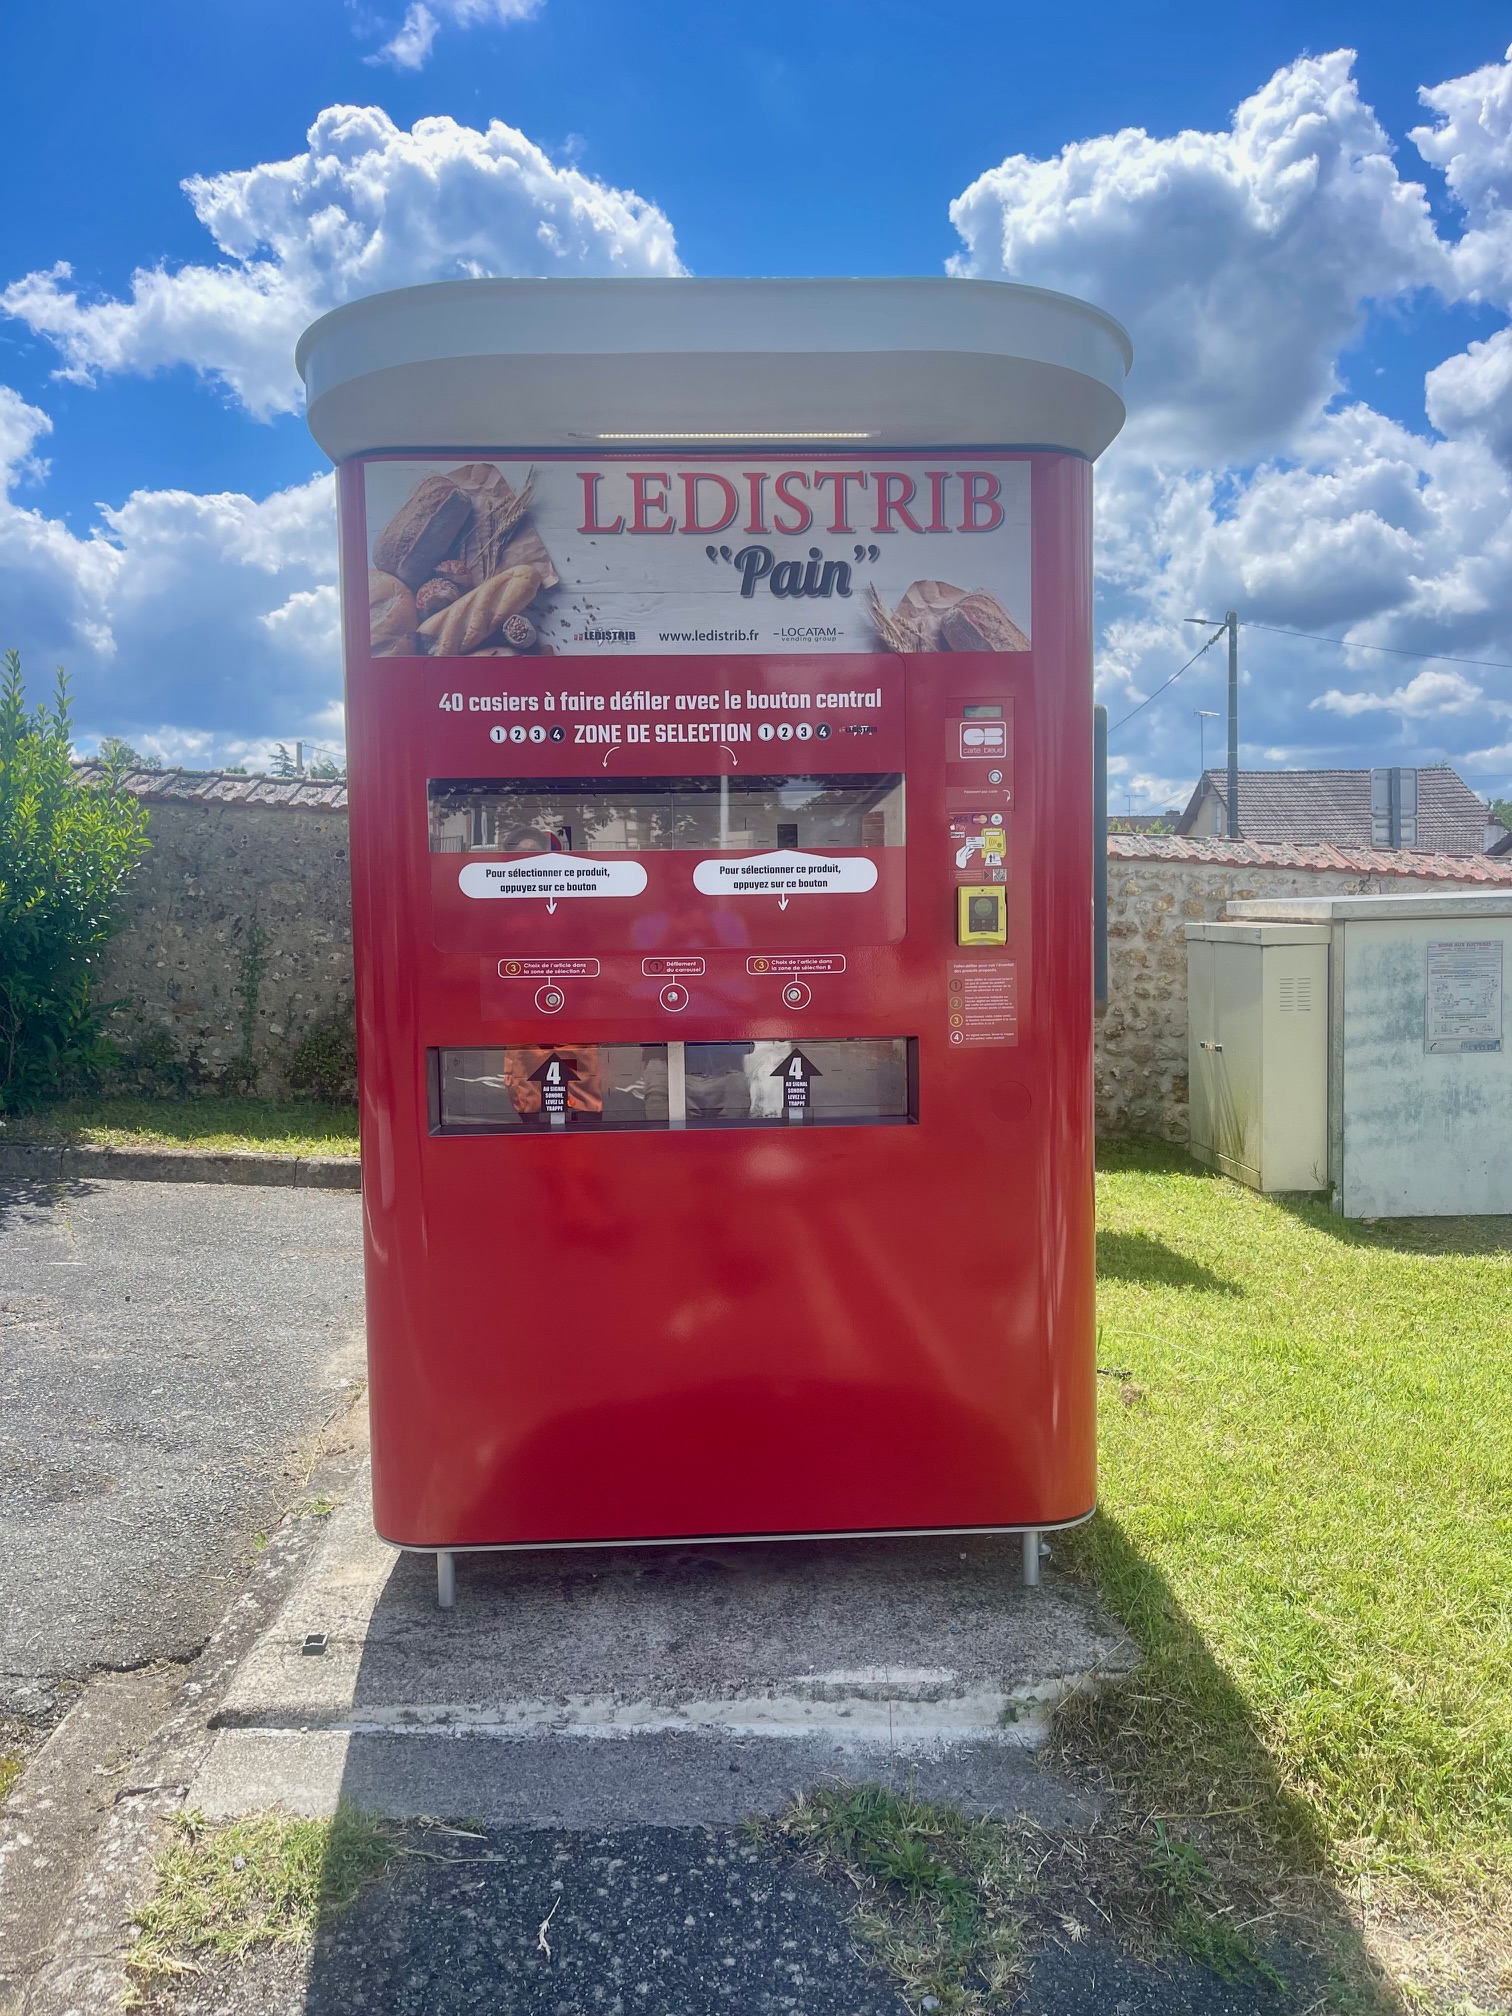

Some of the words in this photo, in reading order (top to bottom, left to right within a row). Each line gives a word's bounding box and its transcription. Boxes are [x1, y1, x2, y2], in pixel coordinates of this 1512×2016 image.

[576, 470, 1004, 534] LEDISTRIB
[584, 630, 636, 641] LEDISTRIB
[658, 629, 759, 642] www.ledistrib.fr
[438, 692, 463, 711] 40
[468, 692, 539, 711] casiers
[543, 691, 555, 711] à
[560, 691, 605, 711] faire
[610, 690, 670, 711] défiler
[675, 694, 719, 710] avec
[724, 690, 741, 709] le
[746, 689, 811, 709] bouton
[816, 688, 882, 708] central
[574, 724, 622, 743] ZONE
[627, 724, 650, 743] DE
[655, 723, 752, 743] SELECTION
[485, 869, 506, 878] Pour
[508, 868, 563, 877] sélectionner
[564, 869, 575, 877] ce
[576, 867, 611, 878] produit,
[719, 866, 739, 875] Pour
[741, 865, 795, 874] sélectionner
[796, 866, 807, 874] ce
[808, 864, 842, 875] produit,
[500, 884, 537, 894] appuyez
[538, 884, 553, 892] sur
[554, 883, 565, 891] ce
[566, 882, 597, 891] bouton
[733, 880, 769, 890] appuyez
[770, 880, 785, 888] sur
[786, 880, 797, 888] ce
[798, 878, 828, 887] bouton
[546, 1062, 561, 1085] 4
[788, 1057, 803, 1080] 4
